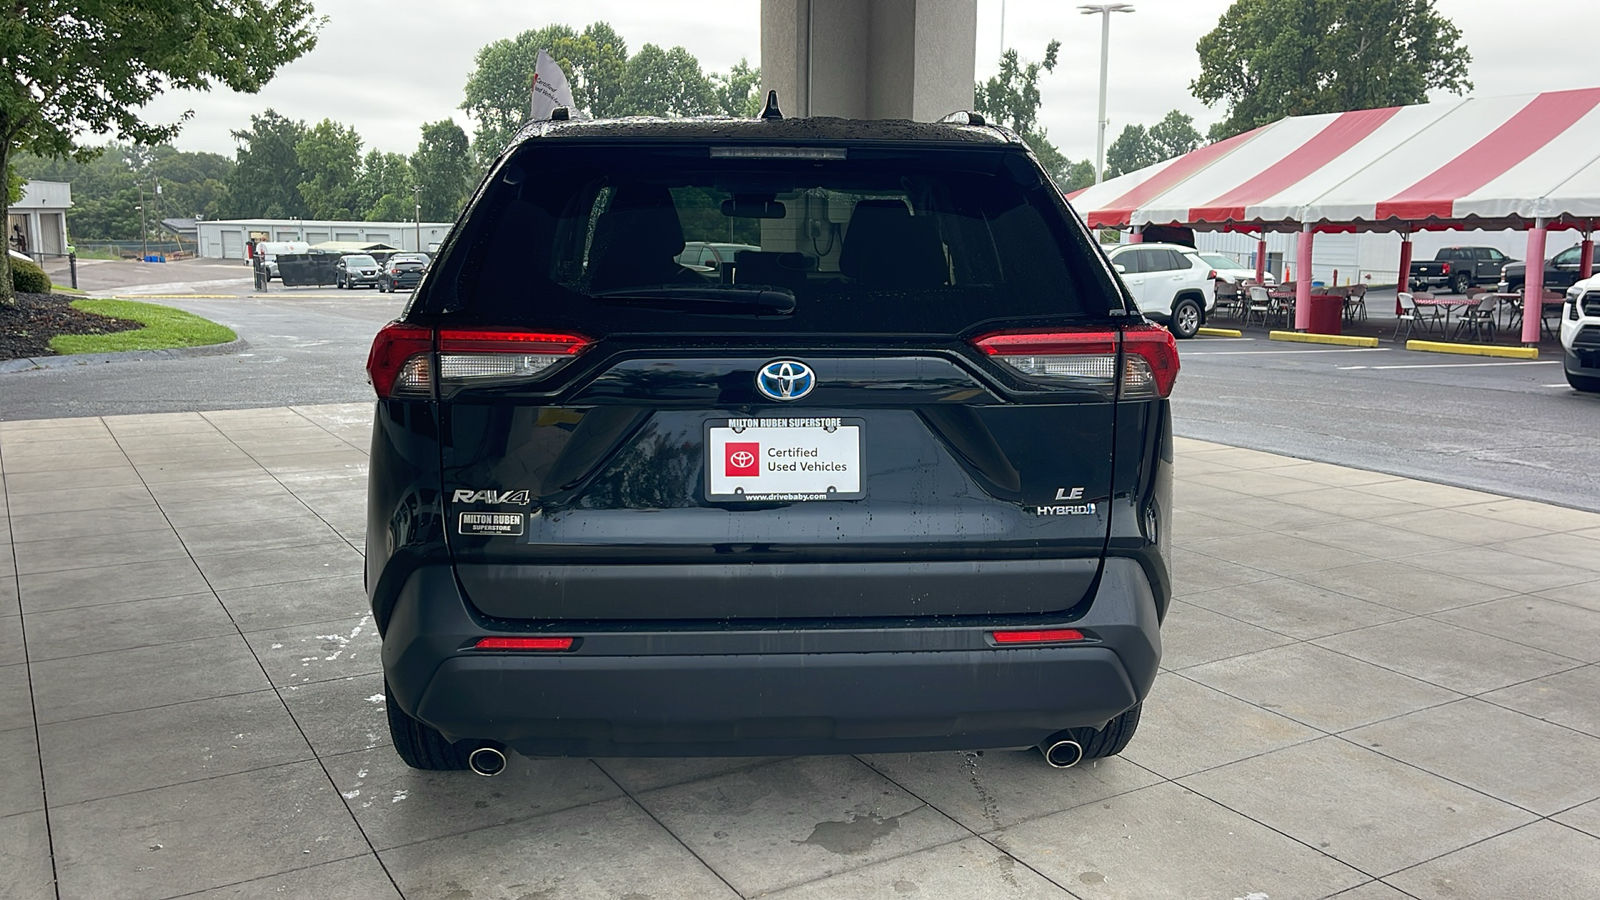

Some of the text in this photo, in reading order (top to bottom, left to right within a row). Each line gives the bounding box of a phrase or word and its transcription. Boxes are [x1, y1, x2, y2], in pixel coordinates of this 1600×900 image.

[728, 418, 841, 428] MILTON RUBEN SUPERSTORE
[767, 447, 818, 458] Certified
[767, 461, 847, 472] Used Vehicles
[452, 489, 530, 505] RAV4
[745, 493, 827, 501] www.drivebaby.com
[1055, 487, 1084, 500] LE
[1037, 505, 1088, 516] HYBRID
[463, 514, 521, 525] MILTON RUBEN
